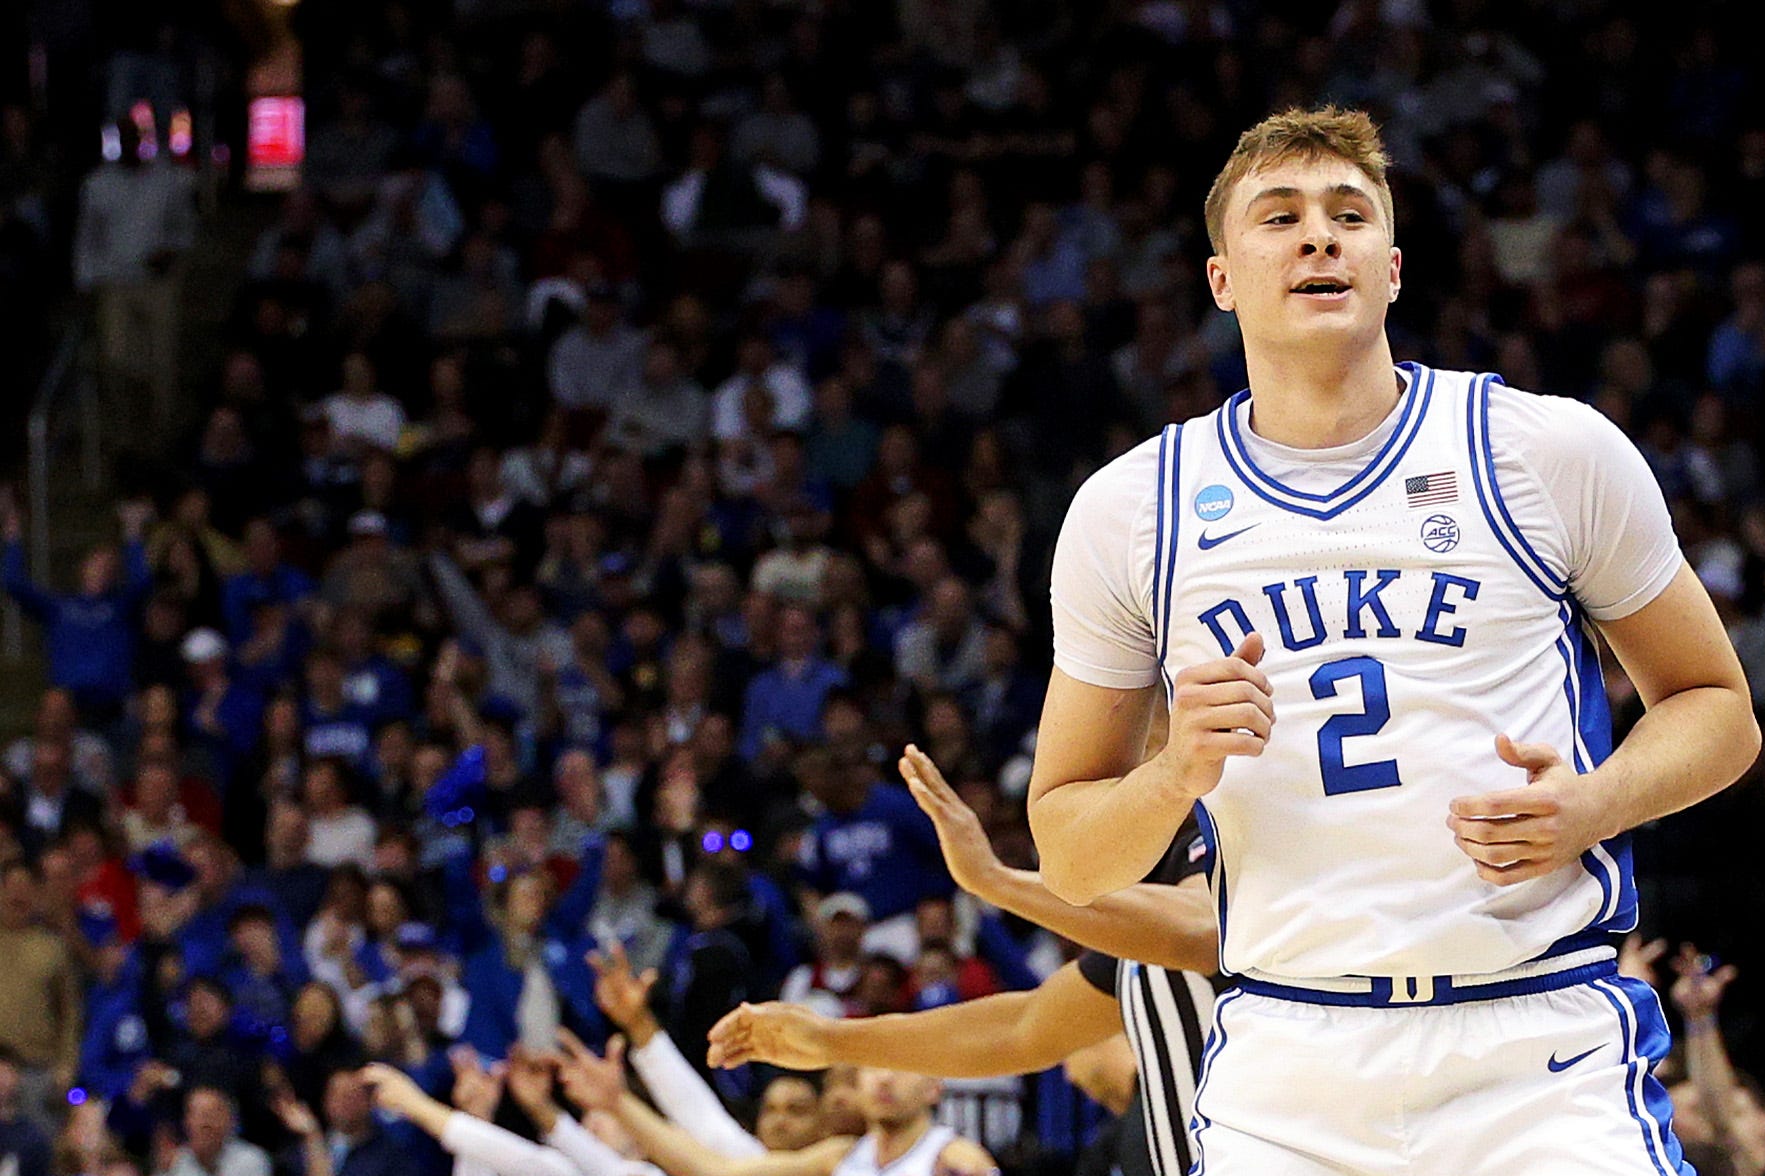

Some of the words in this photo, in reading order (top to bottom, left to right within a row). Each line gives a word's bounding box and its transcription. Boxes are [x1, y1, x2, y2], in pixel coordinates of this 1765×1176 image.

[1198, 500, 1231, 513] NCAA
[1426, 525, 1456, 537] ACC
[1197, 570, 1481, 657] DUKE
[1308, 655, 1402, 797] 2
